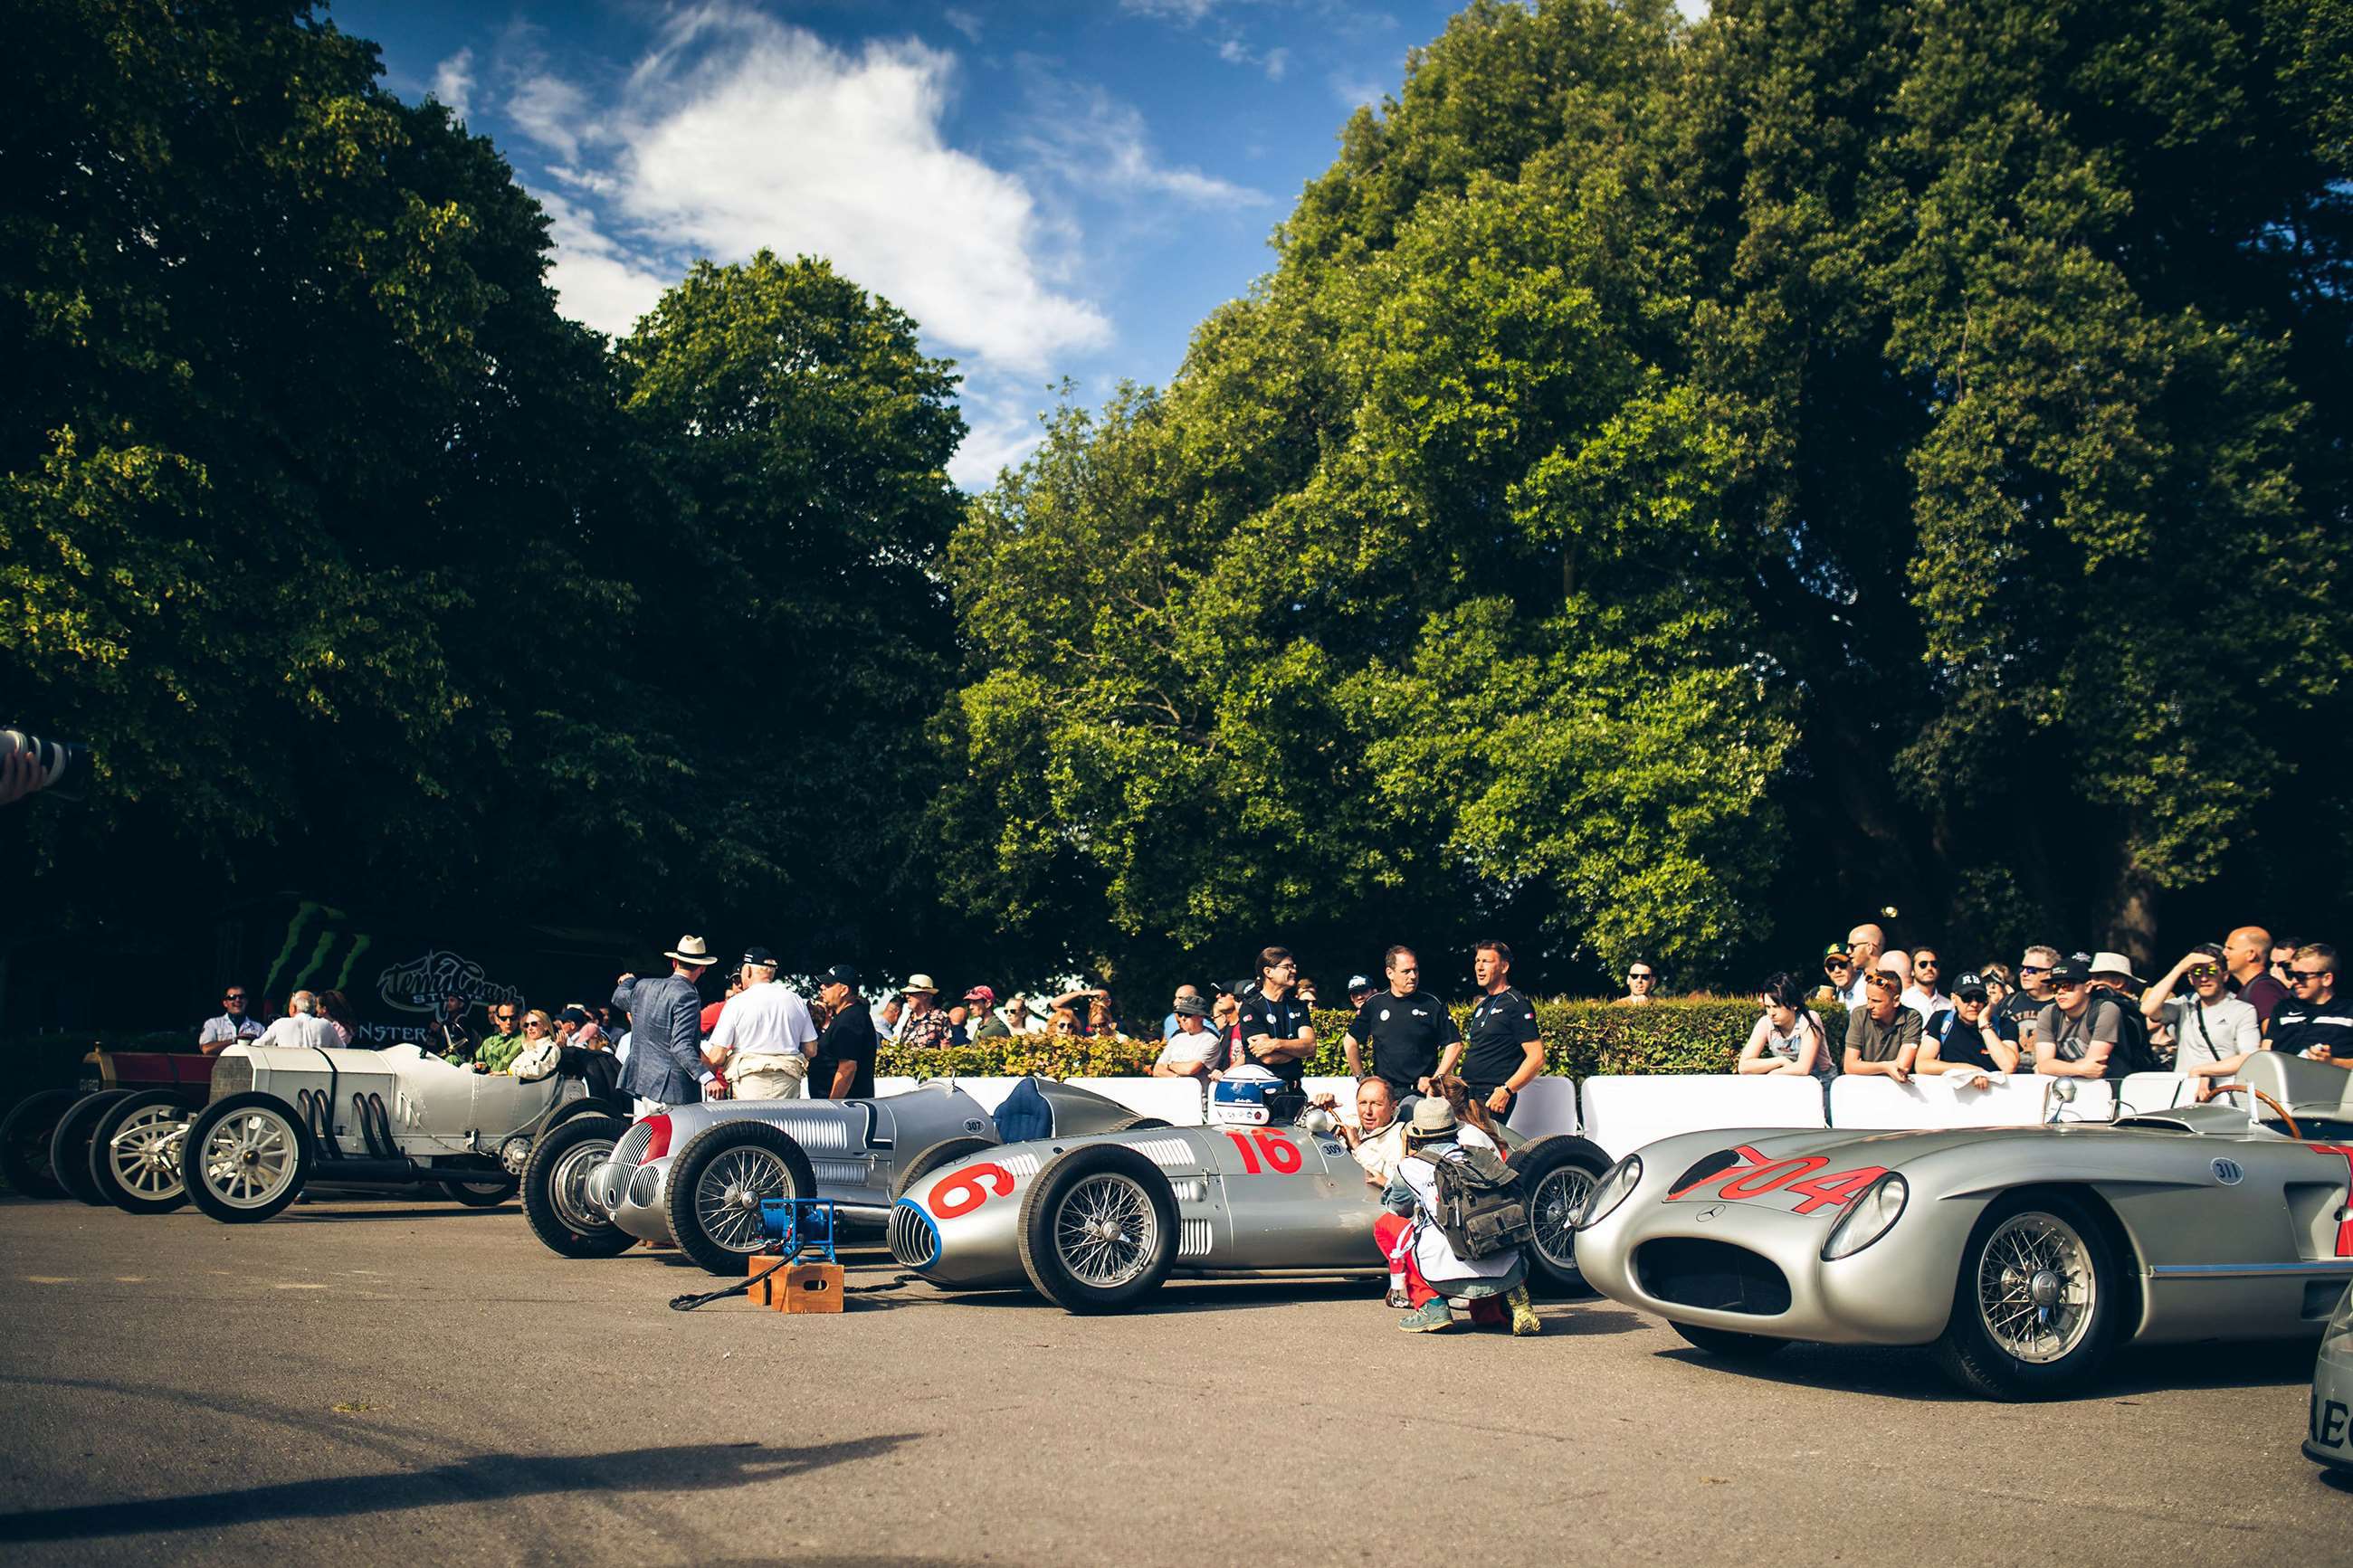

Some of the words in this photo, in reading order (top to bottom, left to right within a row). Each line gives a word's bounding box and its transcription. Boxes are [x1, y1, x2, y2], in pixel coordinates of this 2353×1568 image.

[413, 993, 482, 1004] STUTS
[359, 1022, 427, 1042] NSTER
[1224, 1126, 1303, 1174] 16
[1323, 1145, 1341, 1155] 309
[2216, 1163, 2239, 1178] 311
